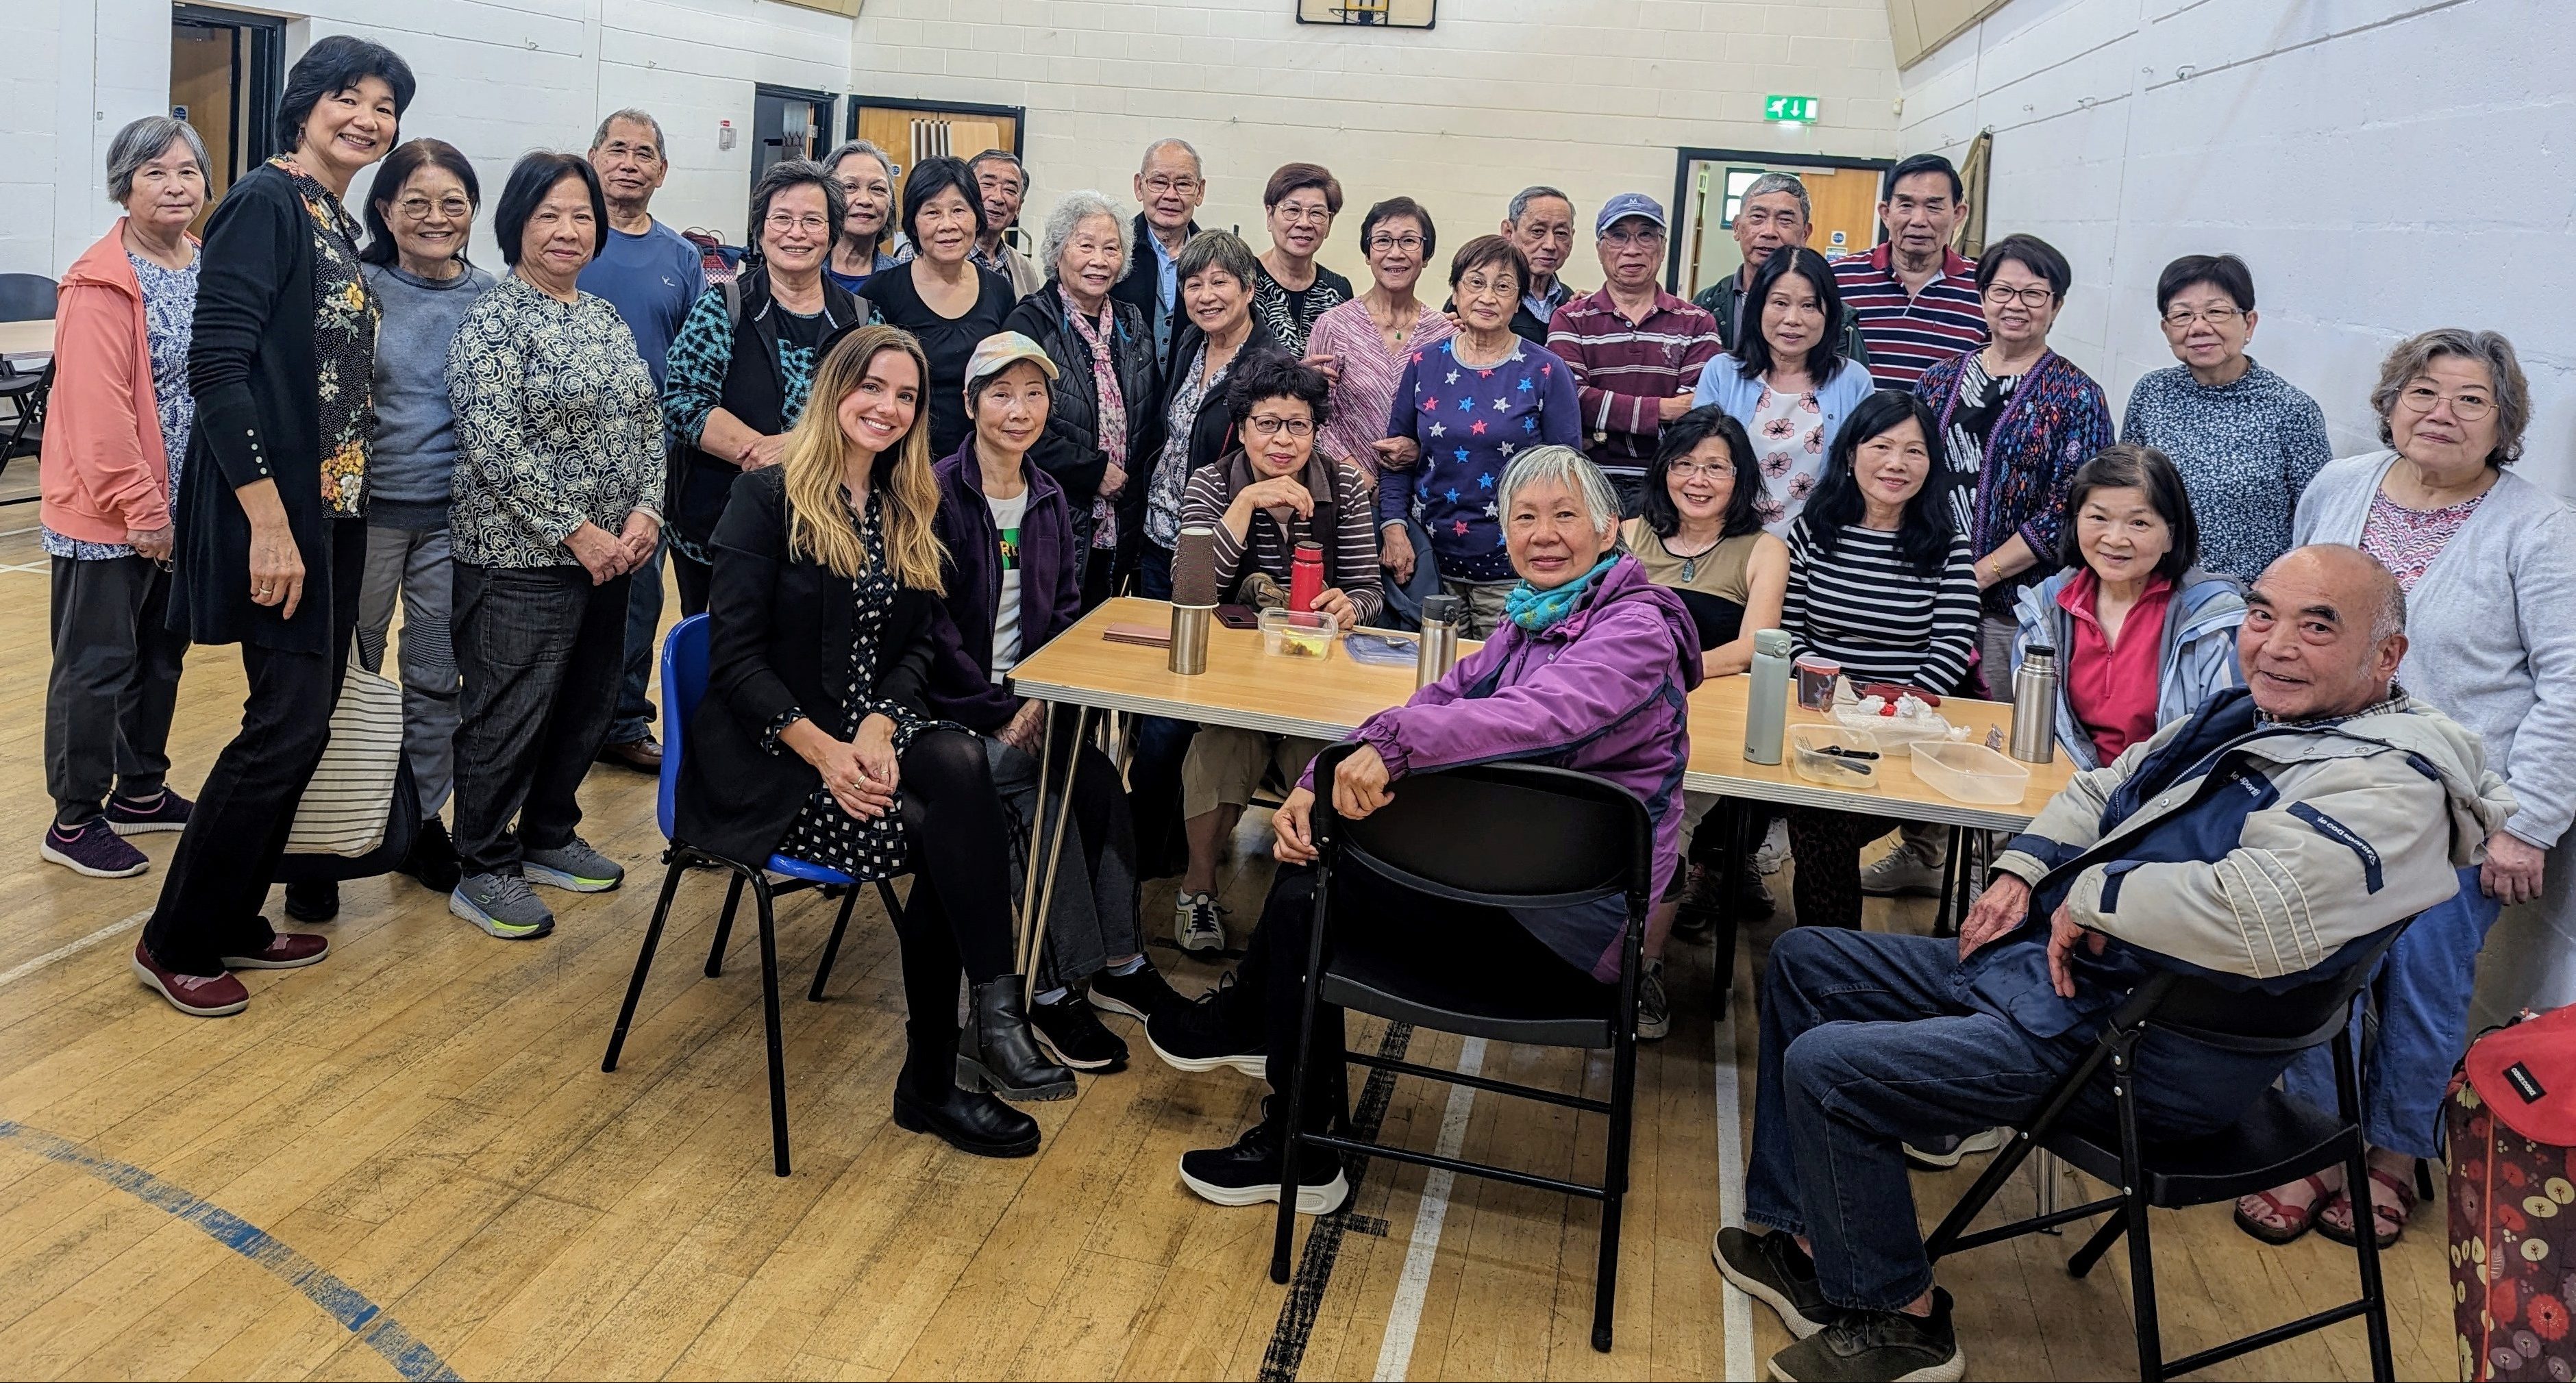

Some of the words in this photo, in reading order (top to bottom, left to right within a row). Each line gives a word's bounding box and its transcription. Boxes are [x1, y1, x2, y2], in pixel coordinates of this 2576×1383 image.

[2230, 771, 2240, 780] le
[2317, 816, 2327, 825] le
[2326, 823, 2345, 836] coq
[2343, 833, 2375, 856] sportif
